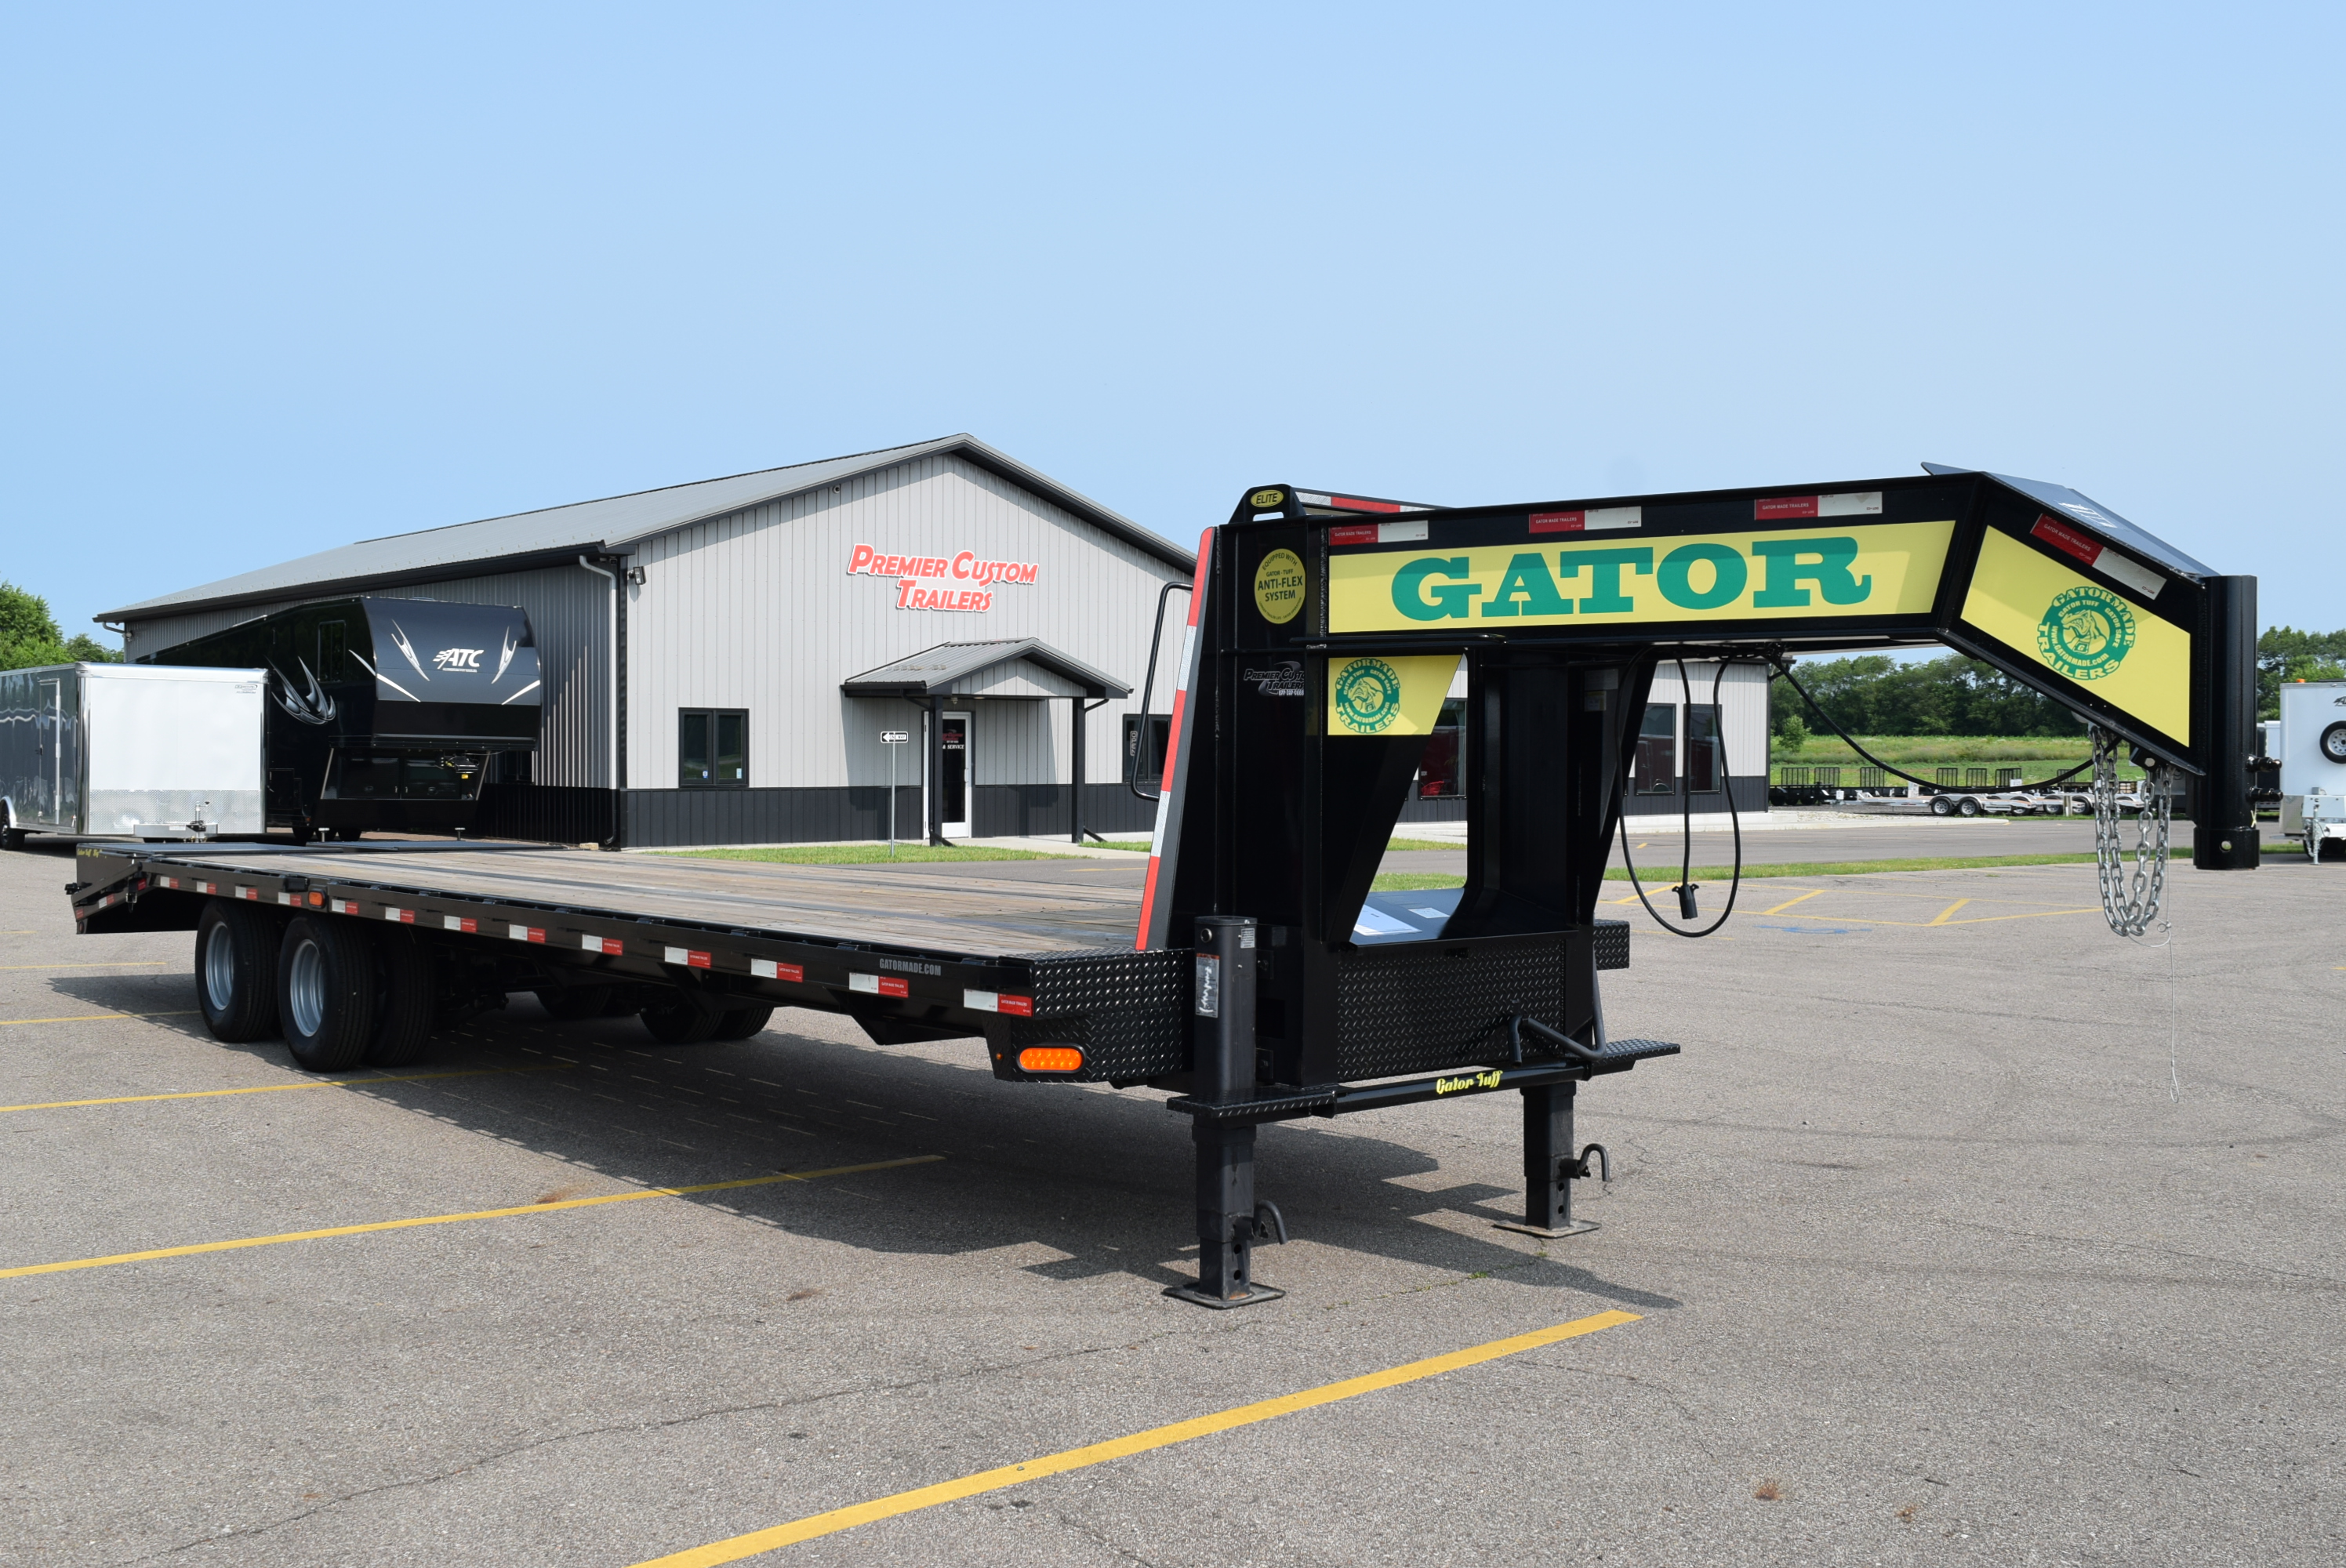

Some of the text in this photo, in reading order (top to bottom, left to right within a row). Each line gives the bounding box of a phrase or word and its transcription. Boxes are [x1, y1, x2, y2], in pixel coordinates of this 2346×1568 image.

[1256, 493, 1278, 504] ELITE
[2043, 524, 2091, 552] GATOR MADE TRAILERS
[848, 544, 1039, 587] PREMIER CUSTOM
[1262, 552, 1298, 571] EQUIPPED WITH
[1257, 575, 1303, 590] ANTI-FLEX
[1391, 536, 1872, 622] GATOR
[897, 579, 993, 612] TRAILERS
[1265, 590, 1296, 602] SYSTEM
[2052, 586, 2136, 648] GATORMADE
[2058, 600, 2081, 617] GATOR
[2104, 607, 2122, 648] GATOR SAFE
[435, 648, 485, 669] ATC
[2037, 622, 2121, 681] TRAILERS
[1244, 669, 1280, 681] PREMIER
[1335, 658, 1400, 690] GATORMADE
[1343, 676, 1354, 695] GATOR
[1370, 669, 1392, 695] GATOR SAFE
[1335, 702, 1400, 734] TRAILERS
[879, 958, 942, 976] GATORMADE.COM
[1436, 1070, 1504, 1094] Gator Tuff
